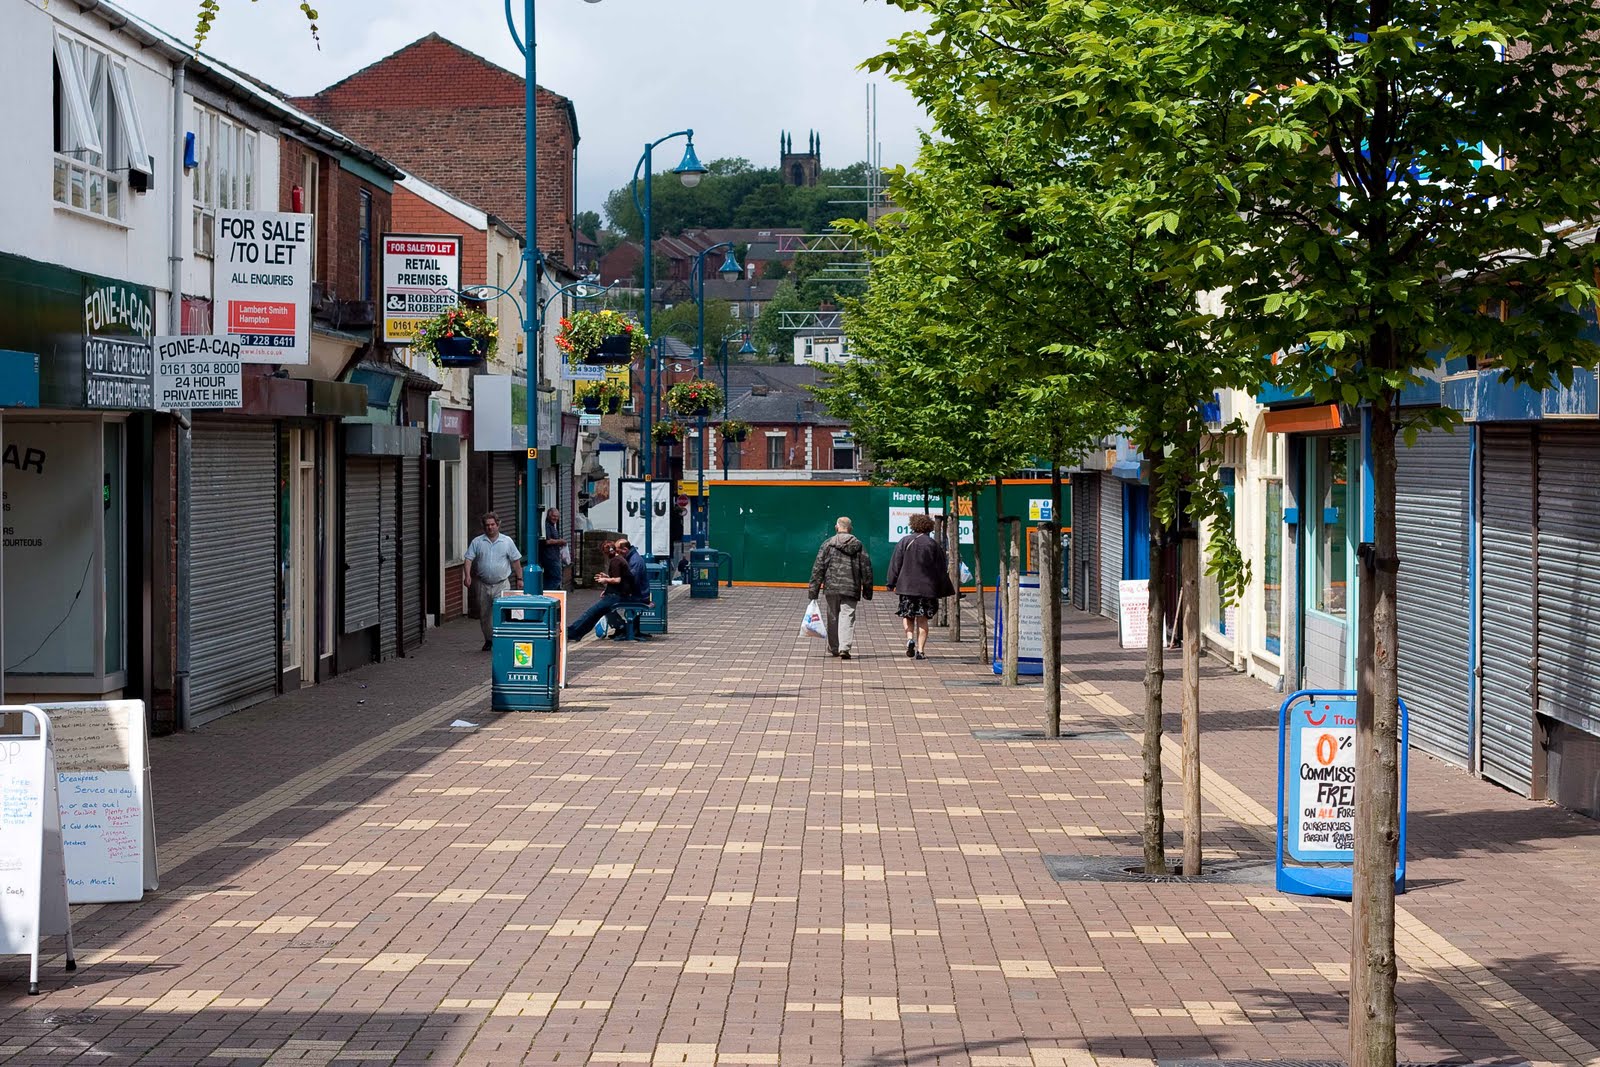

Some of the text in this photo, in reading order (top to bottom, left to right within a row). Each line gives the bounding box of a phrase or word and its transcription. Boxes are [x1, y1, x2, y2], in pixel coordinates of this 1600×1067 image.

[221, 218, 305, 242] FOR SALE
[230, 242, 296, 265] /TO LET
[390, 243, 405, 252] FOR
[437, 244, 451, 253] LET
[405, 258, 440, 271] RETAIL
[231, 273, 294, 286] ALL ENQUIRIES
[397, 273, 448, 286] PREMISES
[407, 294, 455, 304] ROBERTS
[239, 304, 288, 316] Lambert Smith
[407, 303, 451, 313] ROBER
[85, 286, 152, 346] FONE-A-CAR
[239, 315, 270, 326] Hampton
[393, 321, 411, 330] 0161
[241, 335, 293, 346] 61 228 6411
[159, 338, 240, 360] FONE-A-CAR
[85, 341, 152, 375] 0161 304 8000
[160, 363, 240, 375] 0161 304 8000
[175, 376, 226, 388] 24 HOUR
[87, 380, 151, 407] 24 HOUR PRIVATE HIRE
[163, 389, 238, 401] PRIVATE HIRE
[2, 444, 46, 474] AR
[529, 449, 536, 457] 9
[1300, 763, 1356, 782] COMMISS
[1304, 807, 1355, 819] ON ALL FORE
[1302, 821, 1351, 832] CURRENCIES
[1303, 832, 1354, 843] FOREIGN TRAVEL
